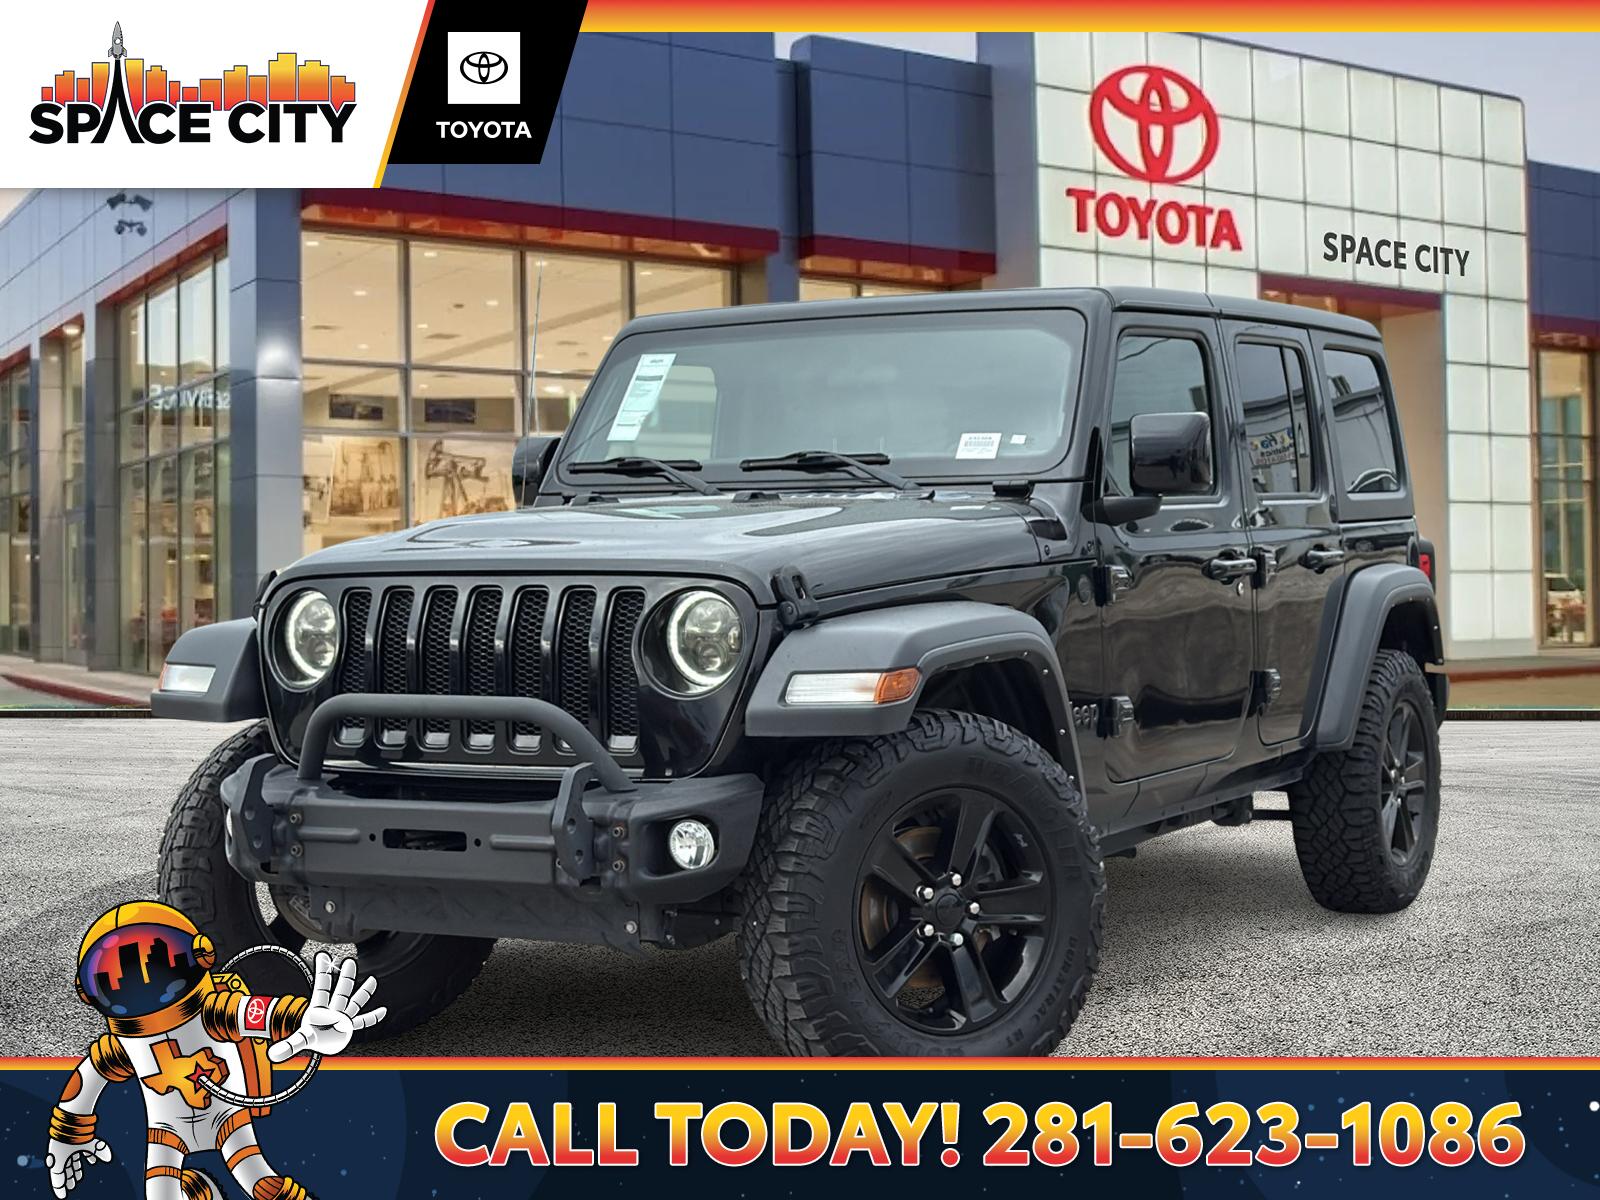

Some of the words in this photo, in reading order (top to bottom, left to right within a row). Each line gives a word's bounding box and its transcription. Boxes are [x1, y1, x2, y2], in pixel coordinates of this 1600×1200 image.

[1065, 187, 1243, 252] TOYOTA
[1322, 231, 1407, 270] SPACE
[1414, 243, 1470, 277] CITY
[1068, 701, 1100, 729] eep
